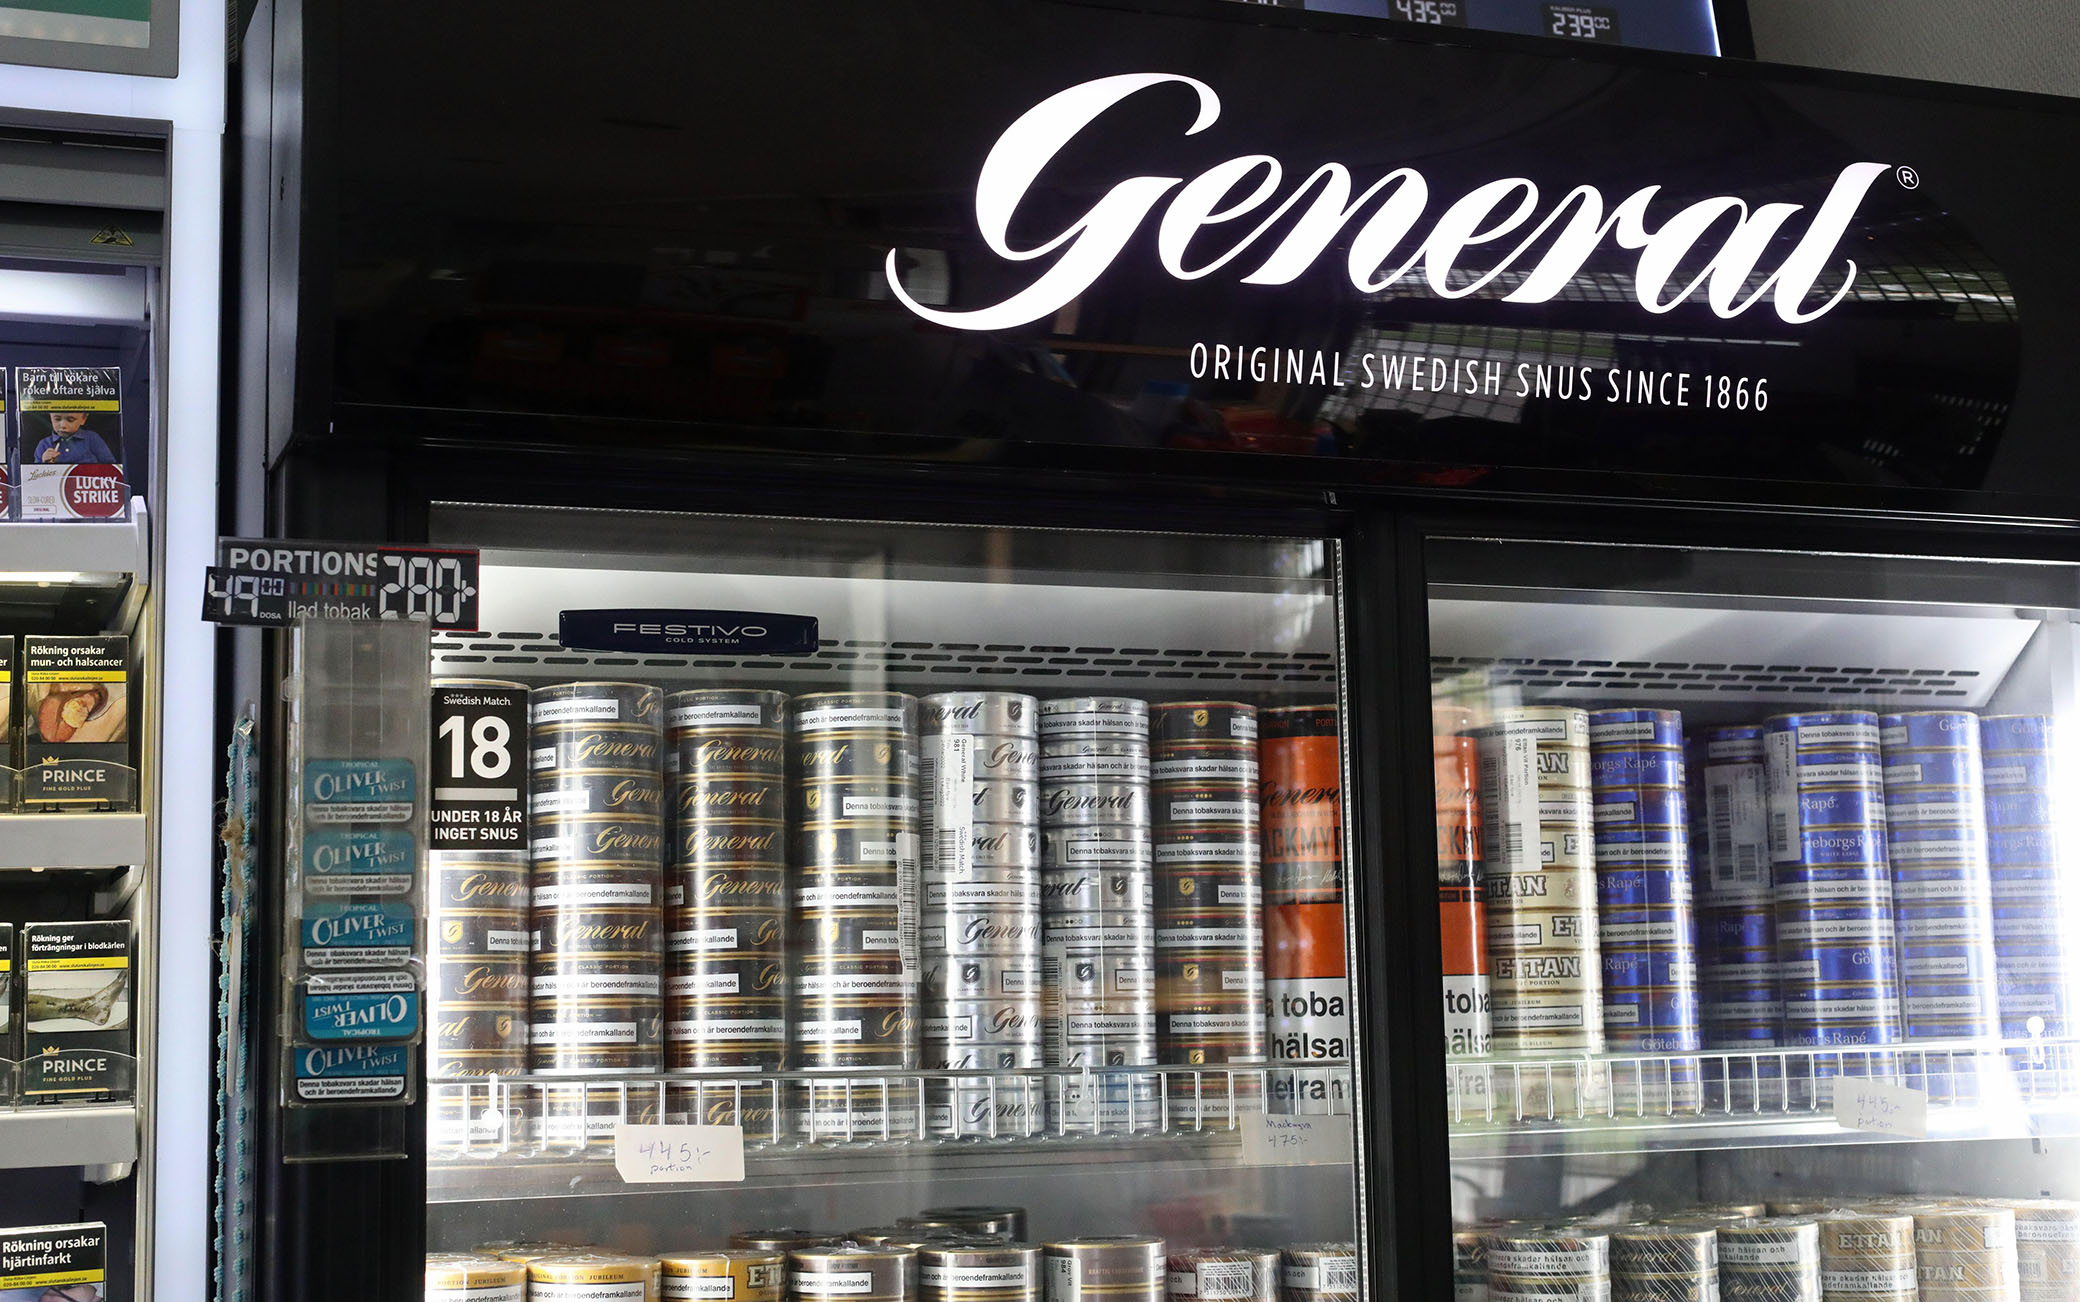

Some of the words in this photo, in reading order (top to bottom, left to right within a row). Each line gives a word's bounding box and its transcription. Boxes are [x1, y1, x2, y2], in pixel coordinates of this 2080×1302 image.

[885, 73, 1892, 331] General
[1190, 341, 1345, 388] ORIGINAL
[1360, 352, 1501, 396] SWEDISH
[1515, 362, 1593, 402] SNUS
[1607, 367, 1691, 408] SINCE
[1703, 374, 1769, 412] 1866
[52, 385, 84, 395] oftare
[86, 385, 116, 397] själva
[75, 476, 117, 490] LUCKY
[73, 490, 119, 504] STRIKE
[259, 611, 282, 620] DOSA
[613, 623, 768, 637] FESTIVO
[30, 645, 69, 657] Rökning
[70, 645, 106, 655] orsakar
[30, 659, 55, 667] mun-
[57, 657, 73, 667] och
[75, 657, 123, 667] halscancer
[443, 696, 481, 706] Swedish
[482, 696, 512, 706] Match
[439, 715, 511, 779] 18
[1194, 763, 1218, 773] skadar
[1218, 763, 1239, 773] hälsan
[1623, 755, 1657, 769] Rapé
[42, 769, 106, 783] PRINCE
[314, 770, 386, 801] OLIVER
[368, 779, 408, 796] TWIST
[679, 785, 769, 812] General
[1047, 789, 1135, 817] General
[845, 802, 869, 810] Denna
[1172, 807, 1194, 815] Denna
[1194, 807, 1231, 815] tobaksvara
[431, 810, 481, 823] UNDER
[483, 810, 500, 823] 18
[502, 806, 522, 823] ÅR
[434, 828, 478, 840] INGET
[480, 828, 519, 840] SNUS
[685, 829, 776, 857] General
[313, 841, 386, 873] OLIVER
[862, 847, 885, 856] Denna
[1070, 847, 1092, 855] Denna
[1093, 846, 1129, 855] tobaksvara
[1157, 849, 1176, 857] Denna
[1176, 848, 1214, 857] tobaksvara
[367, 851, 406, 868] TWIST
[1607, 876, 1641, 890] Rapé
[311, 913, 385, 945] OLIVER
[367, 922, 405, 940] TWIST
[31, 934, 61, 944] Rökning
[62, 935, 74, 943] ger
[88, 941, 125, 950] blodkärlen
[865, 936, 888, 945] Denna
[364, 949, 386, 957] skadar
[1605, 958, 1638, 972] Rapé
[334, 994, 408, 1028] OLIVER
[1070, 1020, 1093, 1029] Denna
[1171, 1019, 1192, 1028] Denna
[1193, 1019, 1230, 1028] tobaksvara
[42, 1058, 107, 1074] PRINCE
[361, 1053, 399, 1070] TWIST
[299, 1080, 320, 1088] Denna
[358, 1078, 380, 1087] skadar
[304, 1087, 318, 1096] och
[318, 1087, 327, 1095] är
[2, 1239, 52, 1253] Rökning
[55, 1235, 100, 1249] orsakar
[2, 1252, 72, 1271] hjärtinfarkt
